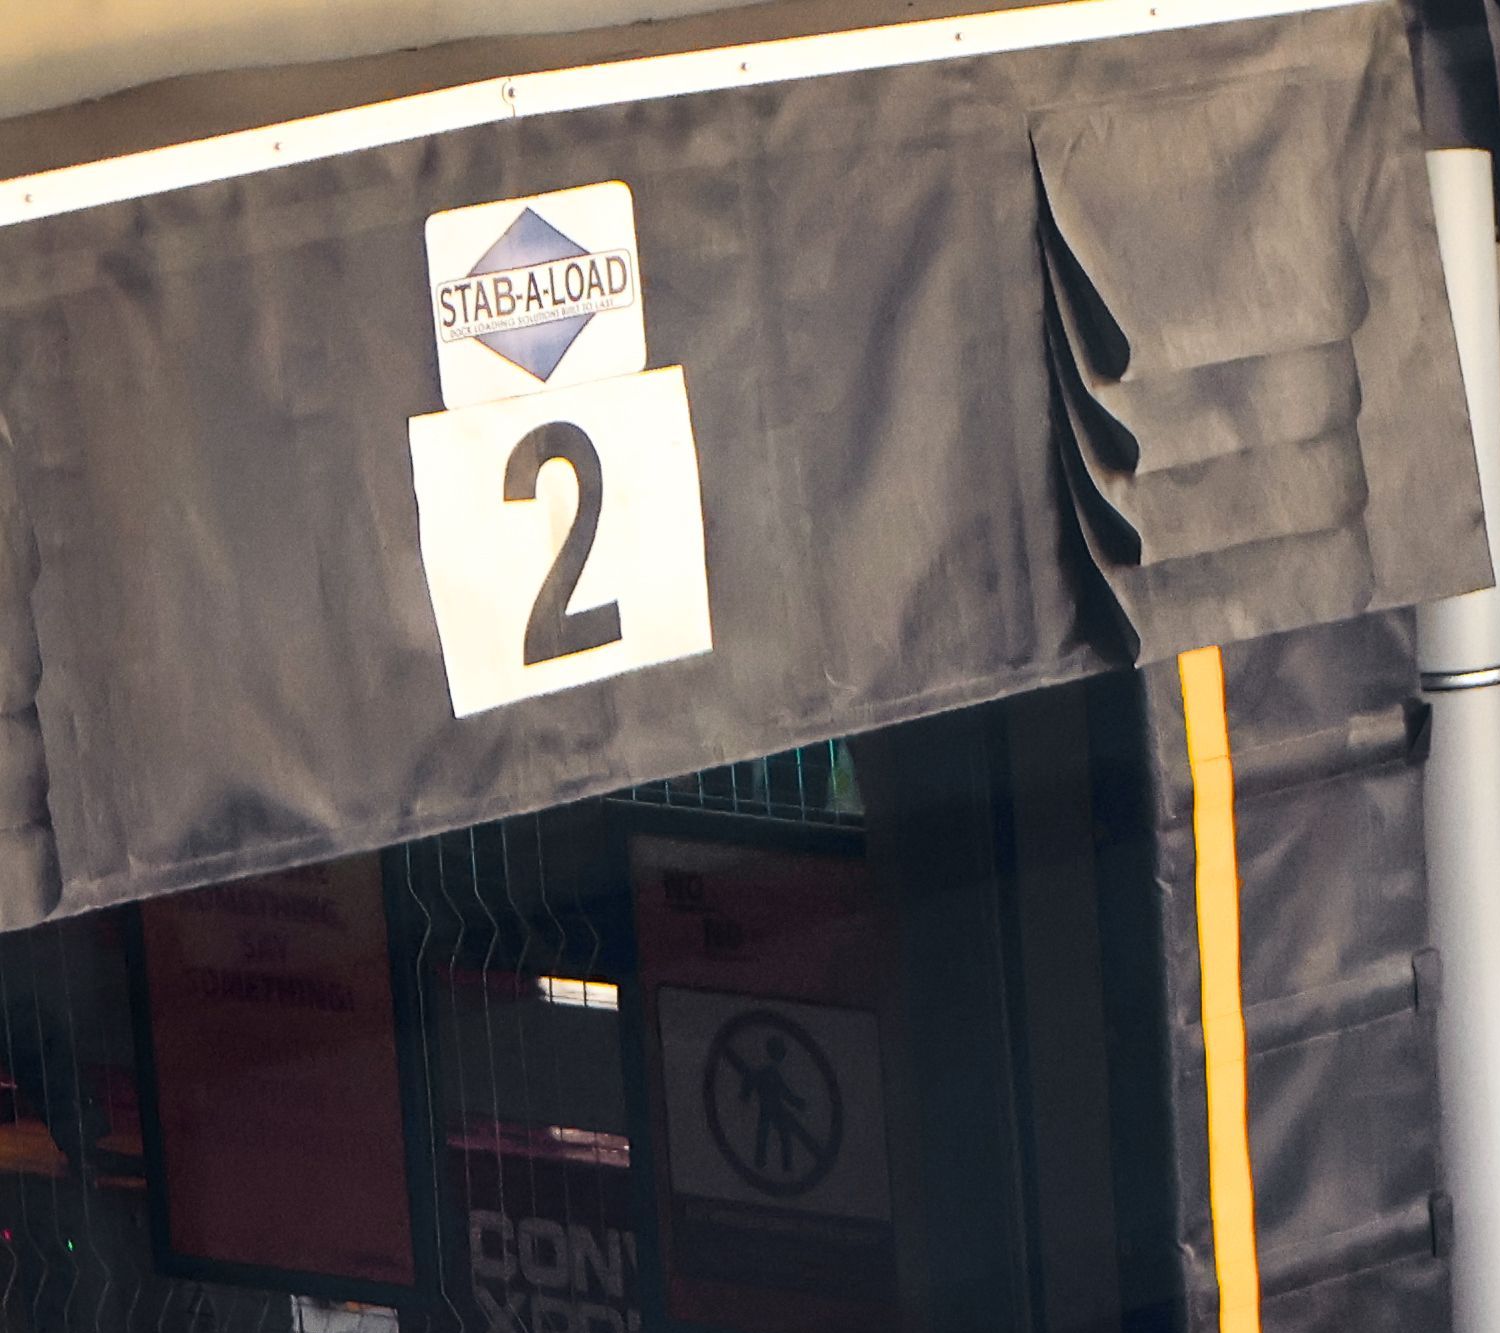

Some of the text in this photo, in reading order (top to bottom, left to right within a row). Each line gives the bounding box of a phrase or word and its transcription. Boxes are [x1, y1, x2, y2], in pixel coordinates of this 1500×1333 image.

[440, 255, 628, 328] STAB-A-LOAD
[474, 318, 516, 333] LOADING
[503, 420, 623, 668] 2
